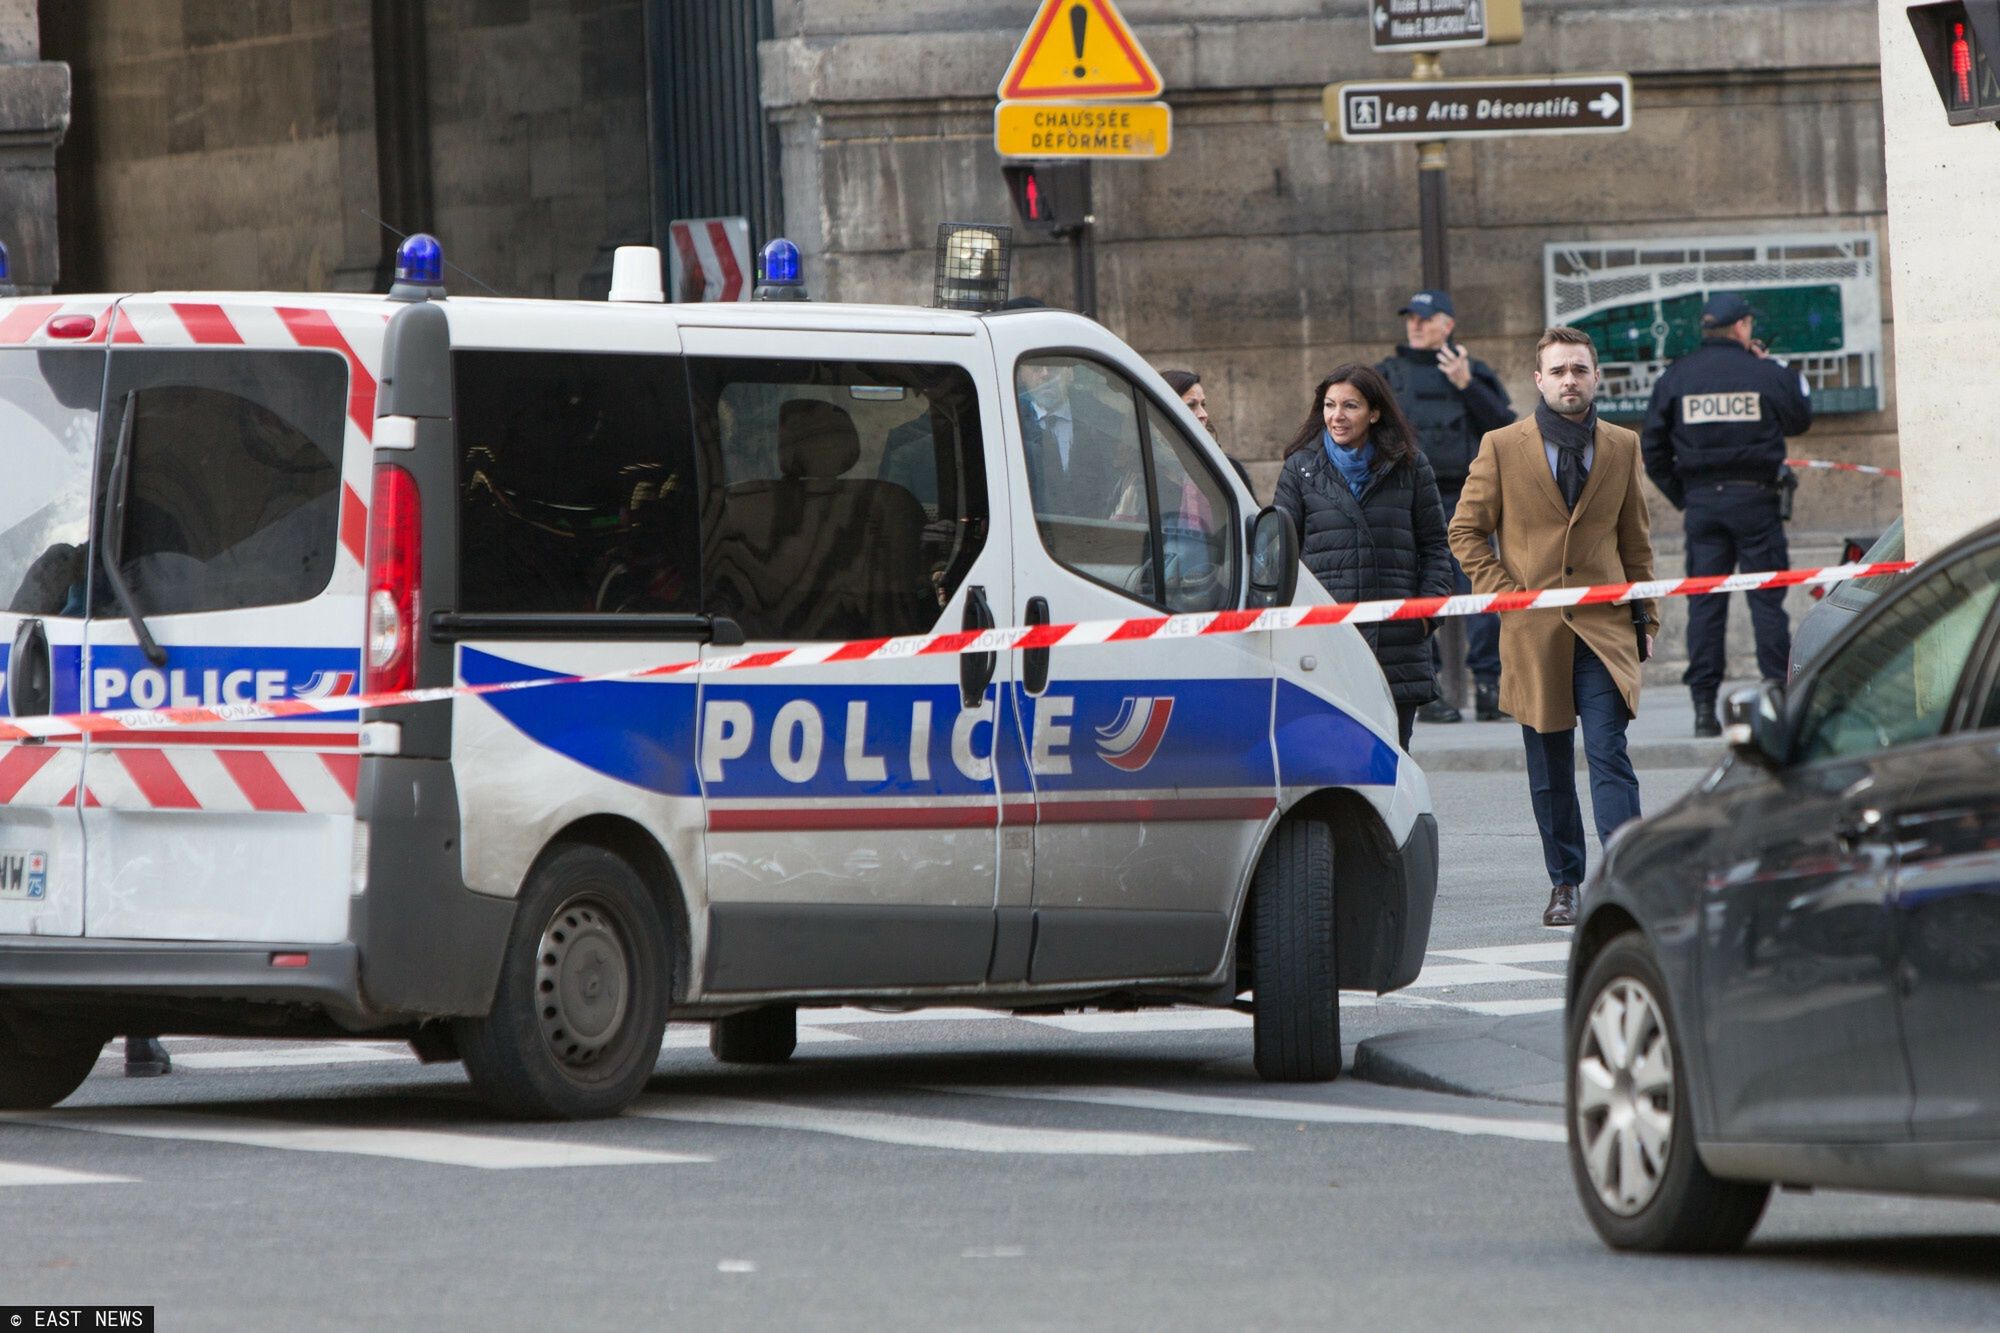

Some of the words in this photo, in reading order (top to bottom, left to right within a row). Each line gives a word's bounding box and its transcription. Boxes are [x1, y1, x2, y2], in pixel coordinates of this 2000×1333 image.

[1034, 110, 1131, 128] CHAUSSÉE
[1385, 102, 1418, 122] Les
[1426, 101, 1469, 121] Arts
[1476, 97, 1579, 120] Décoratifs
[1031, 132, 1132, 149] DÉFORMÉE
[1688, 396, 1755, 418] POLICE
[93, 669, 288, 709] POLICE
[703, 697, 1075, 783] POLICE
